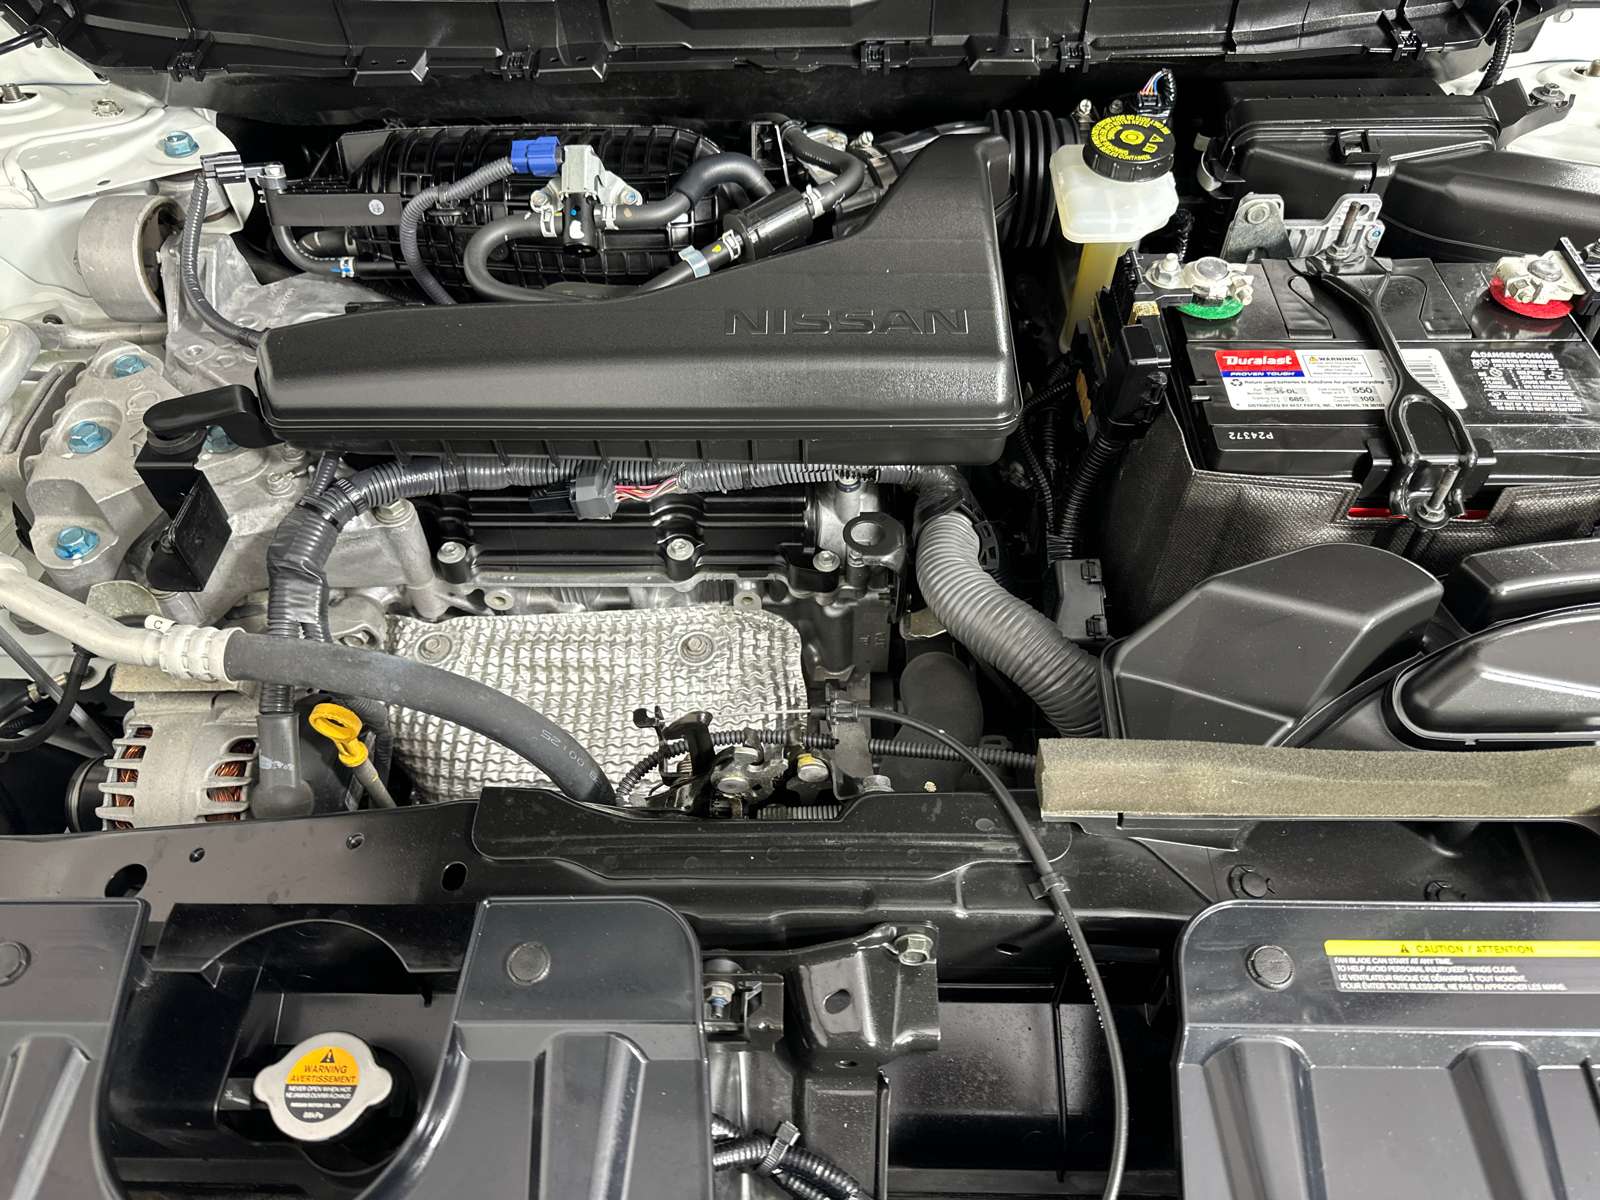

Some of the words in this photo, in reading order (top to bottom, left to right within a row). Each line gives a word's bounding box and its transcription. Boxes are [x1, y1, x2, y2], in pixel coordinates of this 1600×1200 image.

[725, 309, 968, 335] NISSAN
[1222, 355, 1292, 365] Duralast
[1228, 432, 1274, 440] P24372
[154, 620, 163, 629] C
[1416, 945, 1464, 954] CAUTION
[1476, 945, 1534, 954] ATTENTION
[1362, 981, 1385, 990] ÉVITER
[304, 1065, 347, 1073] WARNING
